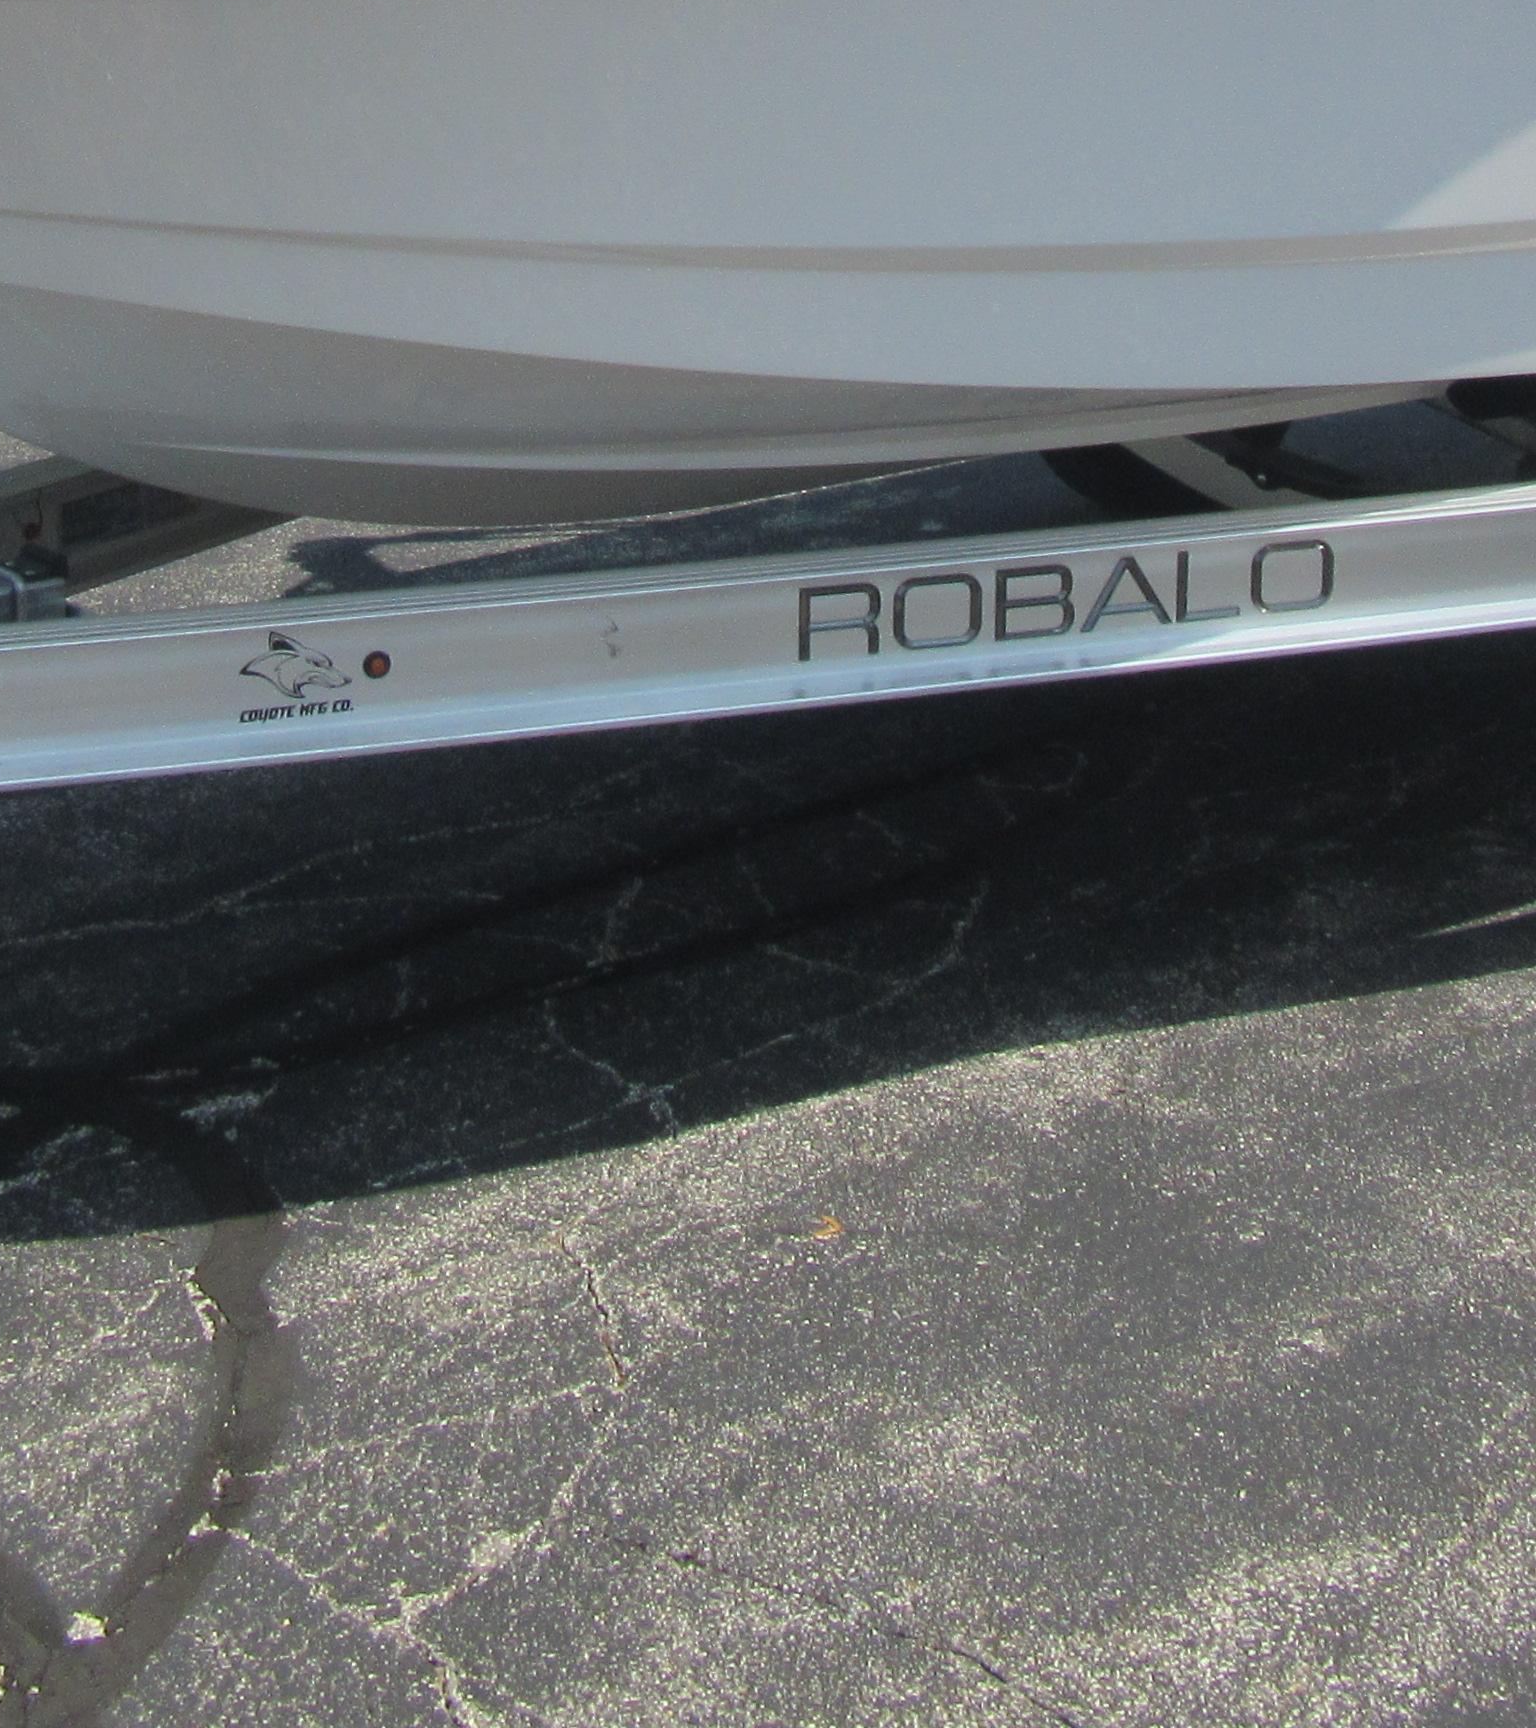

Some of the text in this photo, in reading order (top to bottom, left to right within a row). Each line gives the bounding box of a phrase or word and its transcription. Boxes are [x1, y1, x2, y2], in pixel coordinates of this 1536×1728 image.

[798, 539, 1335, 662] ROBALO
[299, 702, 328, 718] MFG
[332, 699, 354, 712] CO.
